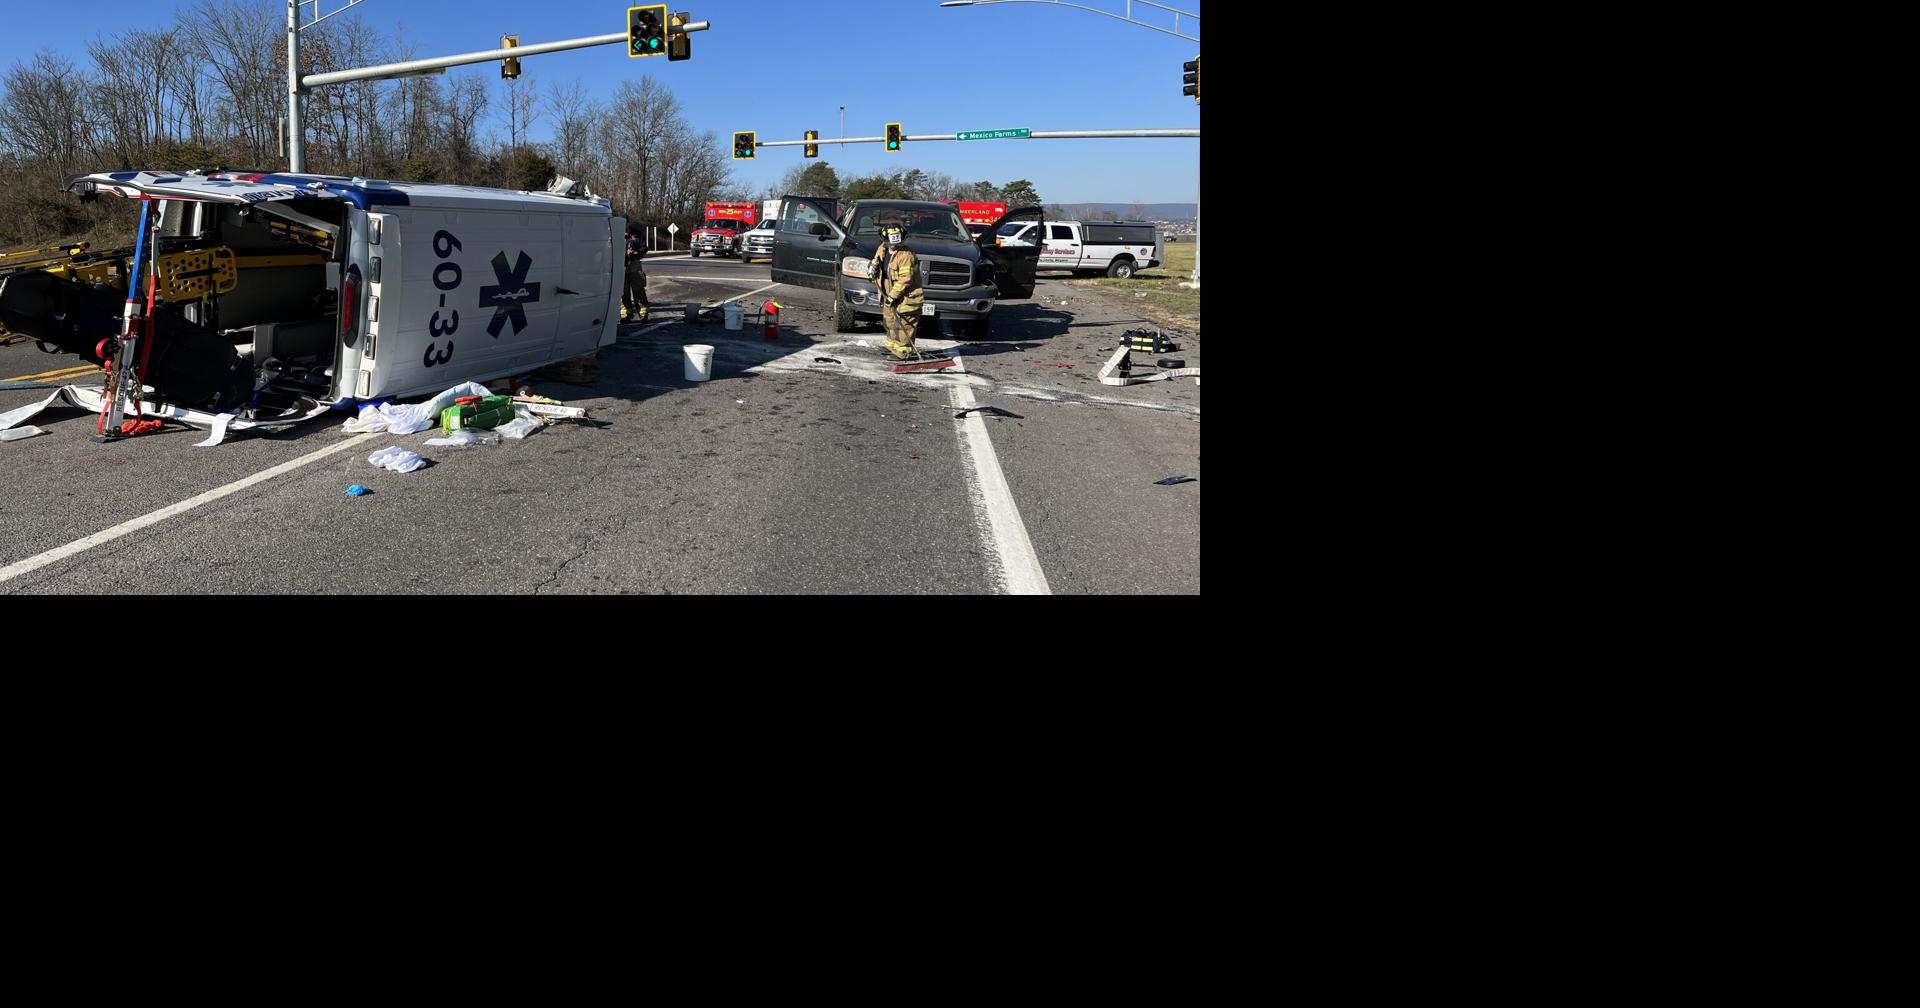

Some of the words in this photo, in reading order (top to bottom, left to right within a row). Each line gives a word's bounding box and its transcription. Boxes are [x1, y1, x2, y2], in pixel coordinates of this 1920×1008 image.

[423, 229, 462, 368] 60-33
[116, 382, 126, 412] RESCUE
[534, 404, 559, 413] RESCUE
